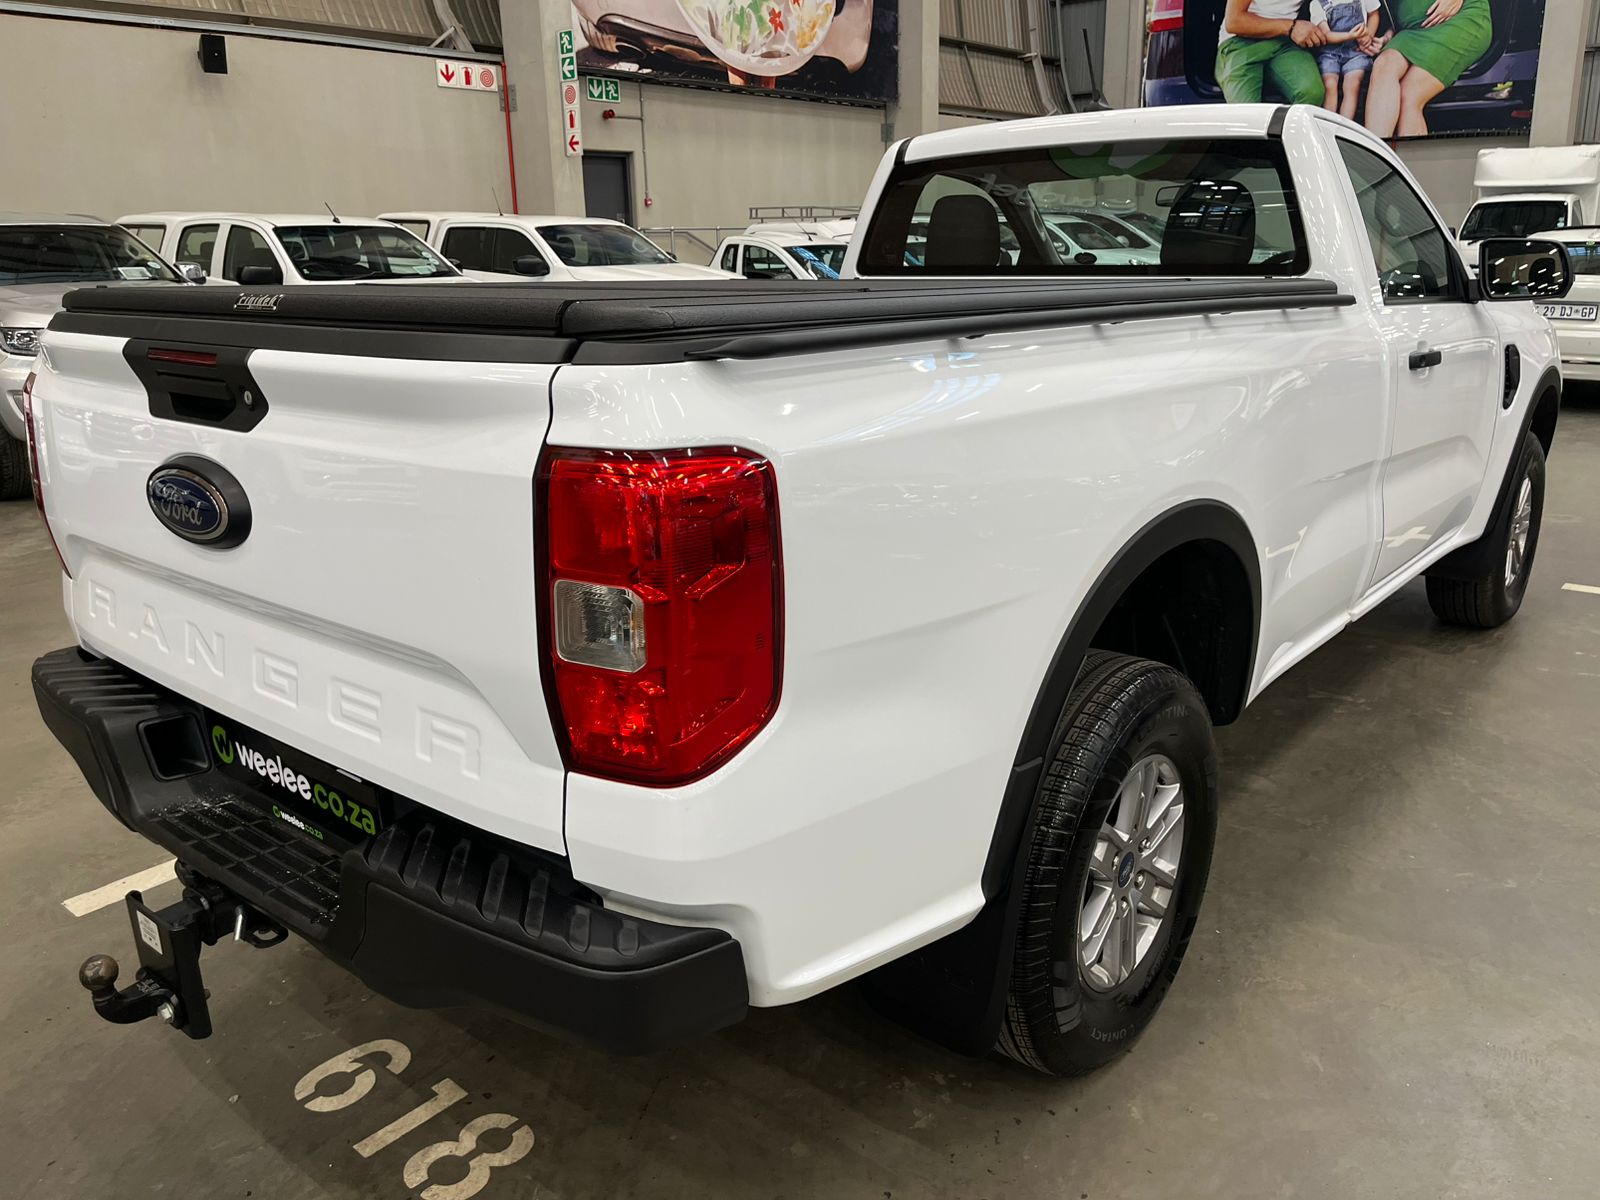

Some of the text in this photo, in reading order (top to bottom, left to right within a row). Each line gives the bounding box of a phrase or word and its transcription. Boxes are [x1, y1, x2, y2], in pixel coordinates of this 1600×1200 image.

[1543, 306, 1595, 318] 29 DJ GP
[87, 579, 482, 781] RANGER
[235, 741, 377, 835] weelee.co.za
[294, 1038, 535, 1200] 618
